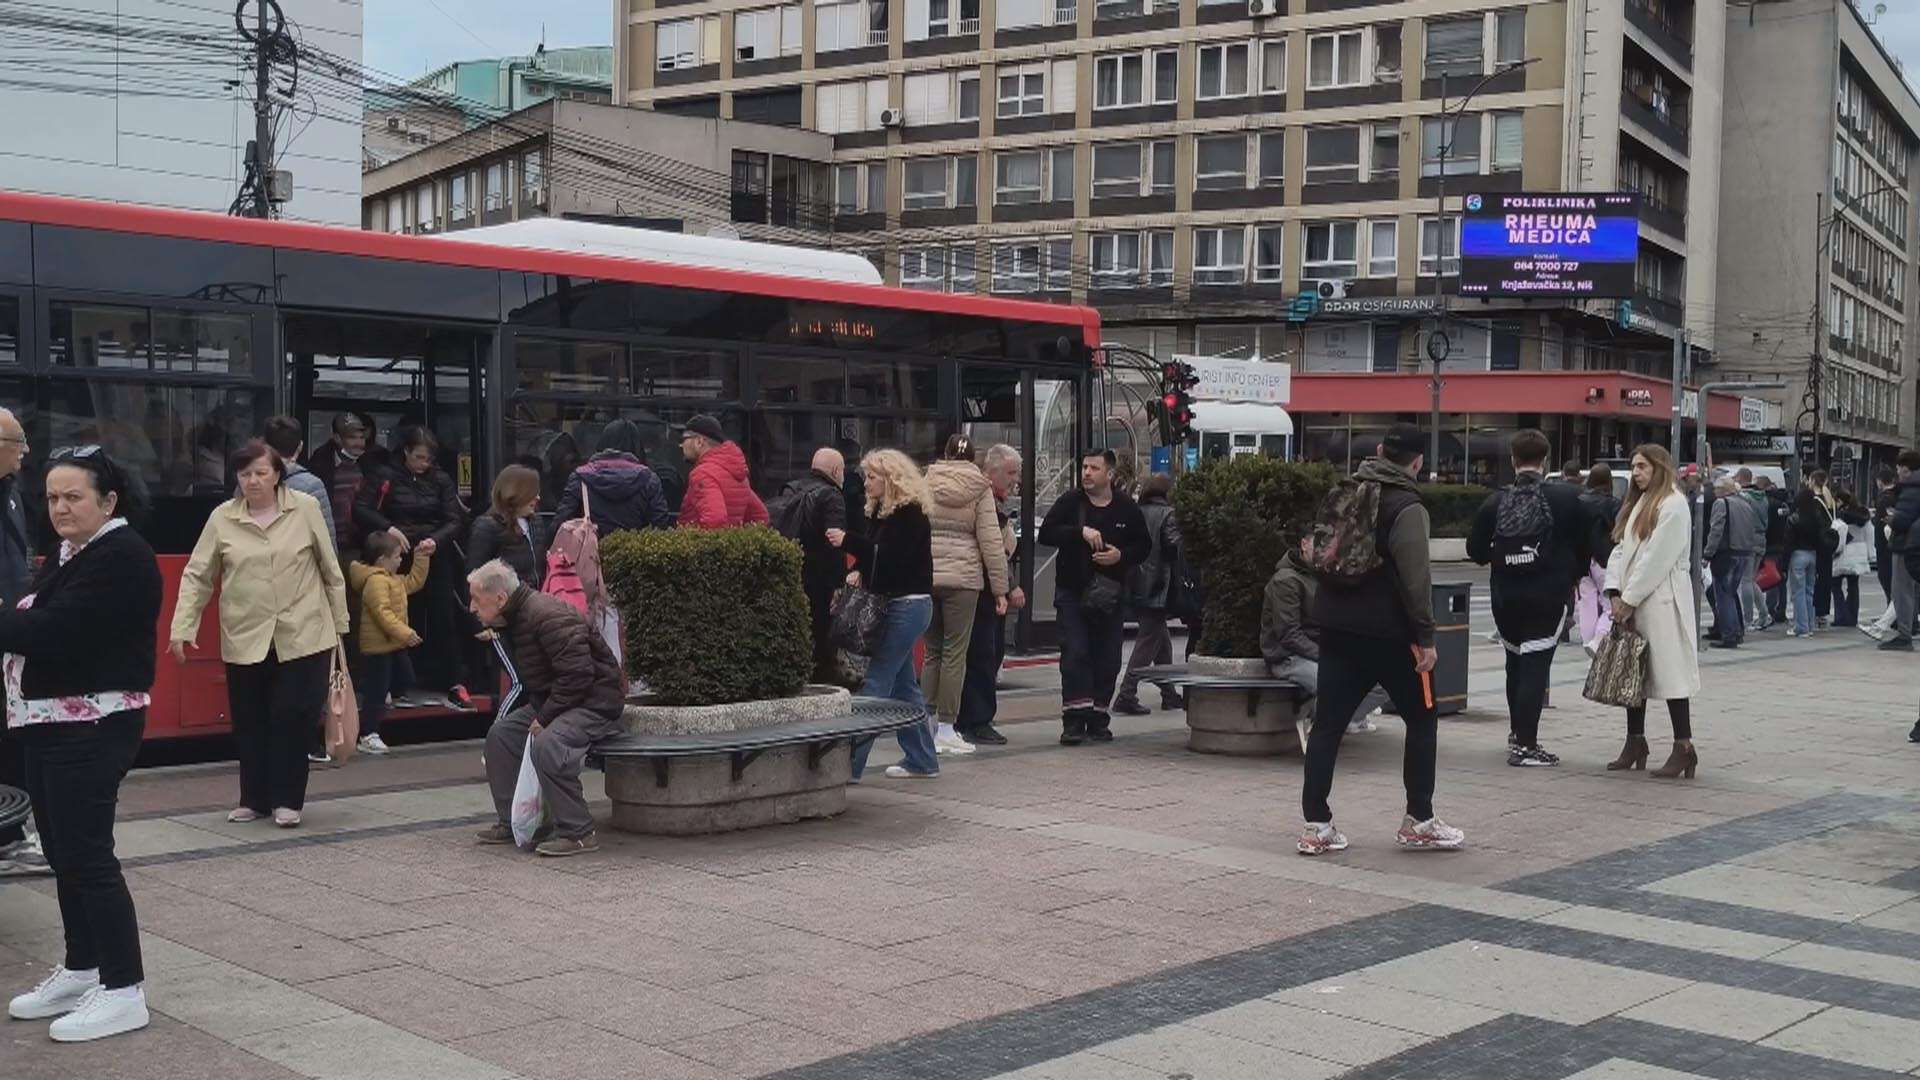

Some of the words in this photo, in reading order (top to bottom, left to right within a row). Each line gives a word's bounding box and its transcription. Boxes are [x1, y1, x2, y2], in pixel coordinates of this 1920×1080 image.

[1503, 198, 1596, 209] POLIKLINIKA
[1505, 214, 1597, 230] RHEUMA
[1508, 230, 1591, 244] MEDICA
[1535, 262, 1561, 271] 7000
[1562, 262, 1579, 271] 727
[1363, 299, 1435, 312] OSIGURANJ
[1225, 369, 1246, 385] INFO
[1247, 373, 1280, 388] CENTER
[1505, 552, 1534, 566] PUMA
